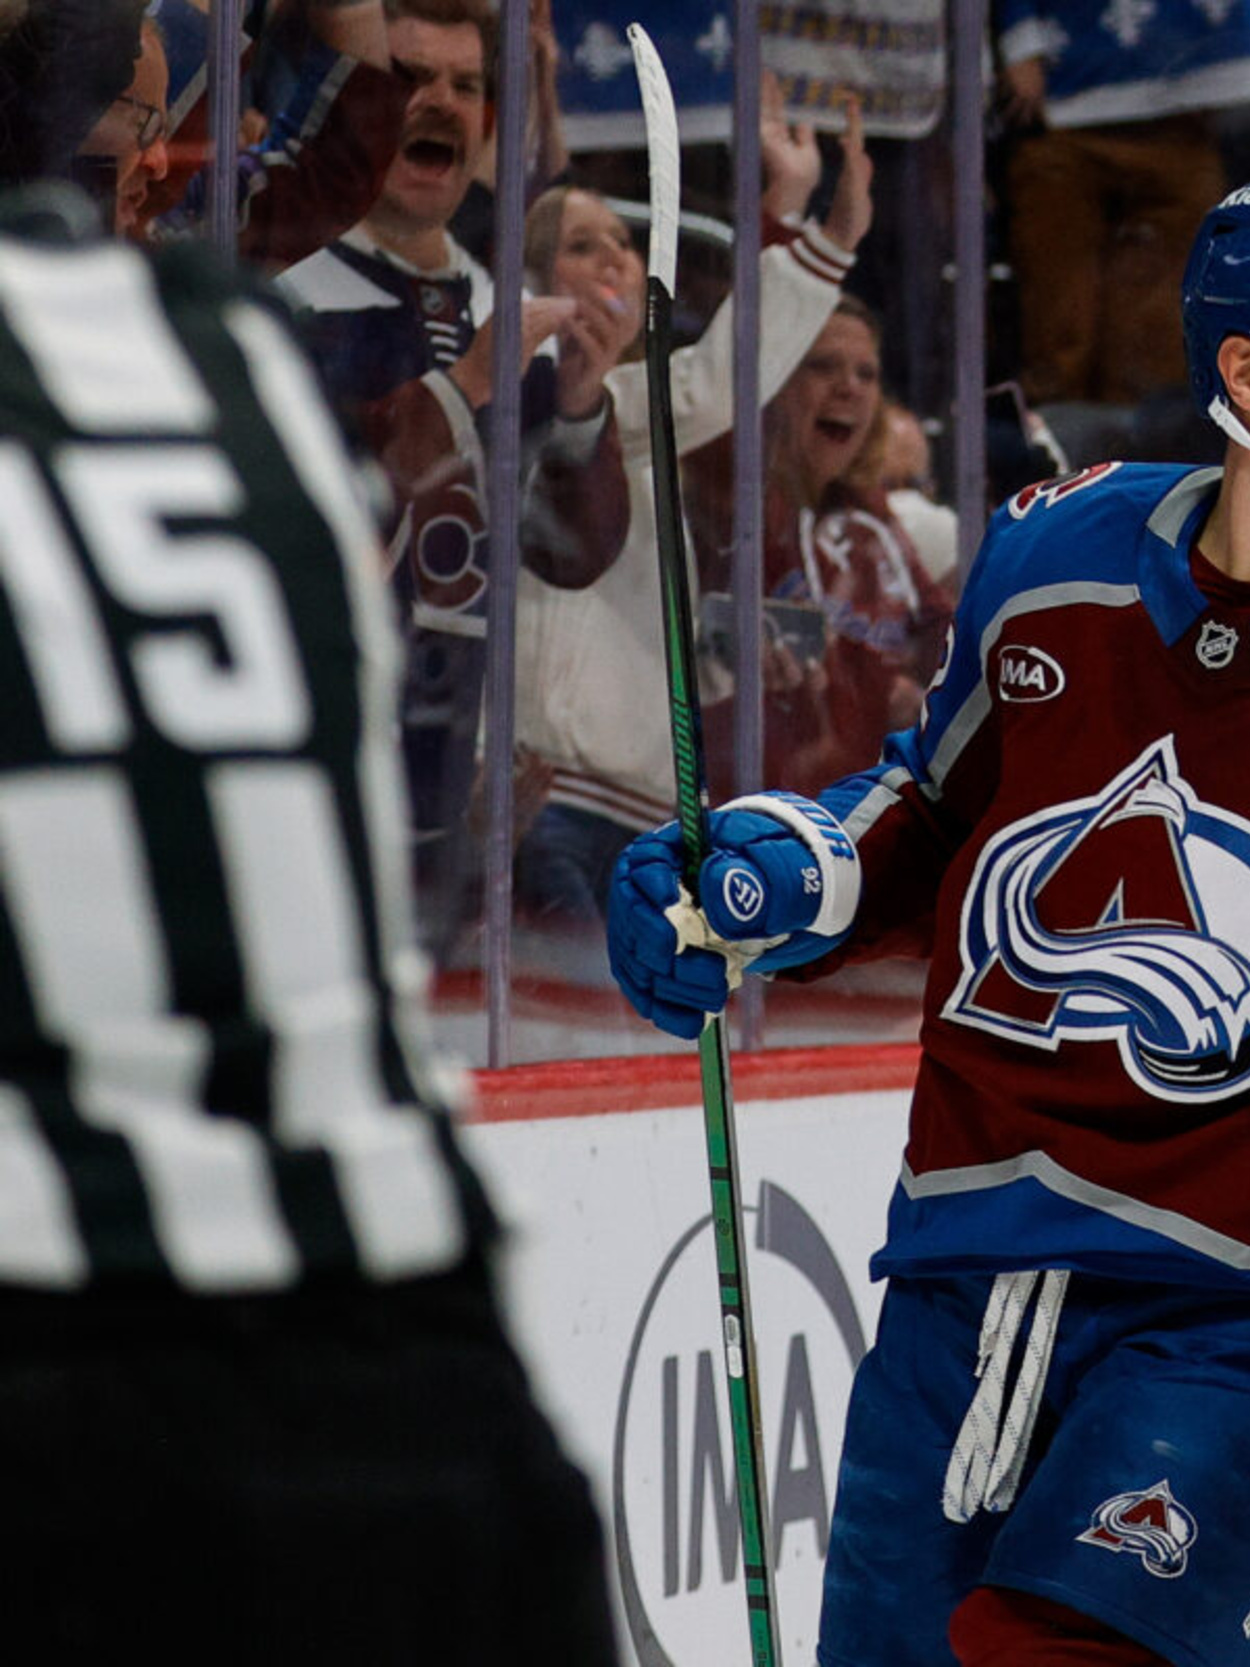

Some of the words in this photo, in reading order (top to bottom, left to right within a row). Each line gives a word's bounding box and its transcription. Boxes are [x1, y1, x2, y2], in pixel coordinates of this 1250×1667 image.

[0, 438, 313, 757] 15
[801, 866, 823, 895] 92
[662, 1330, 831, 1600] IMA
